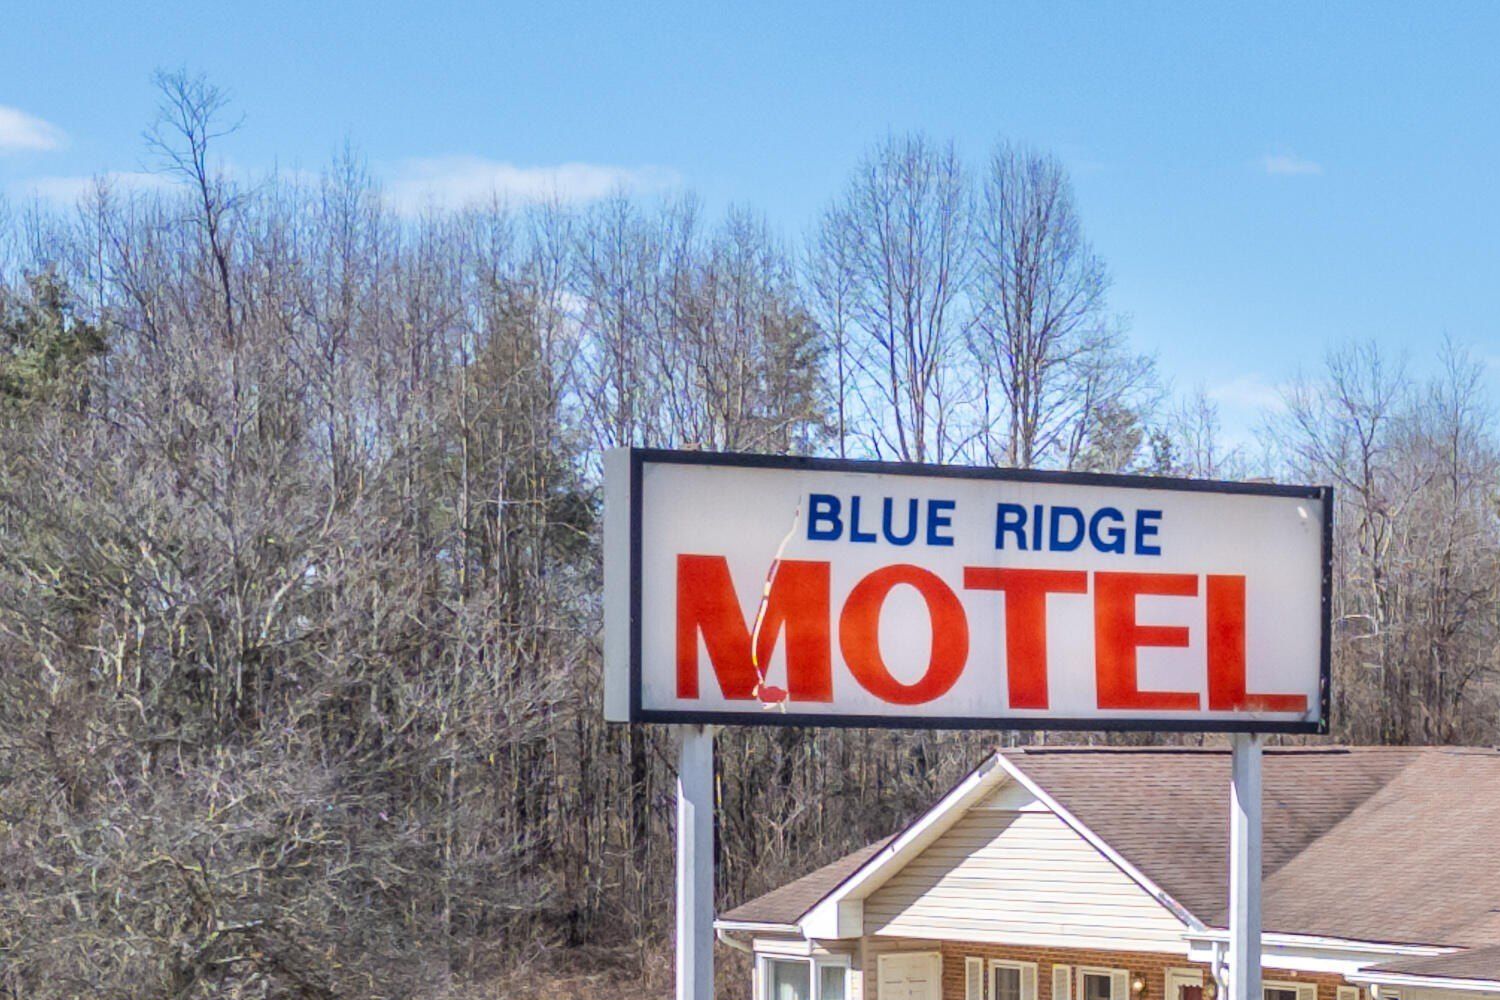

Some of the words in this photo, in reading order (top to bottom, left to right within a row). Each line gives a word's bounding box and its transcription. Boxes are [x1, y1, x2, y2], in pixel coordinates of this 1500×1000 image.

[806, 493, 956, 546] BLUE
[994, 502, 1163, 556] RIDGE
[676, 554, 1308, 712] MOTEL
